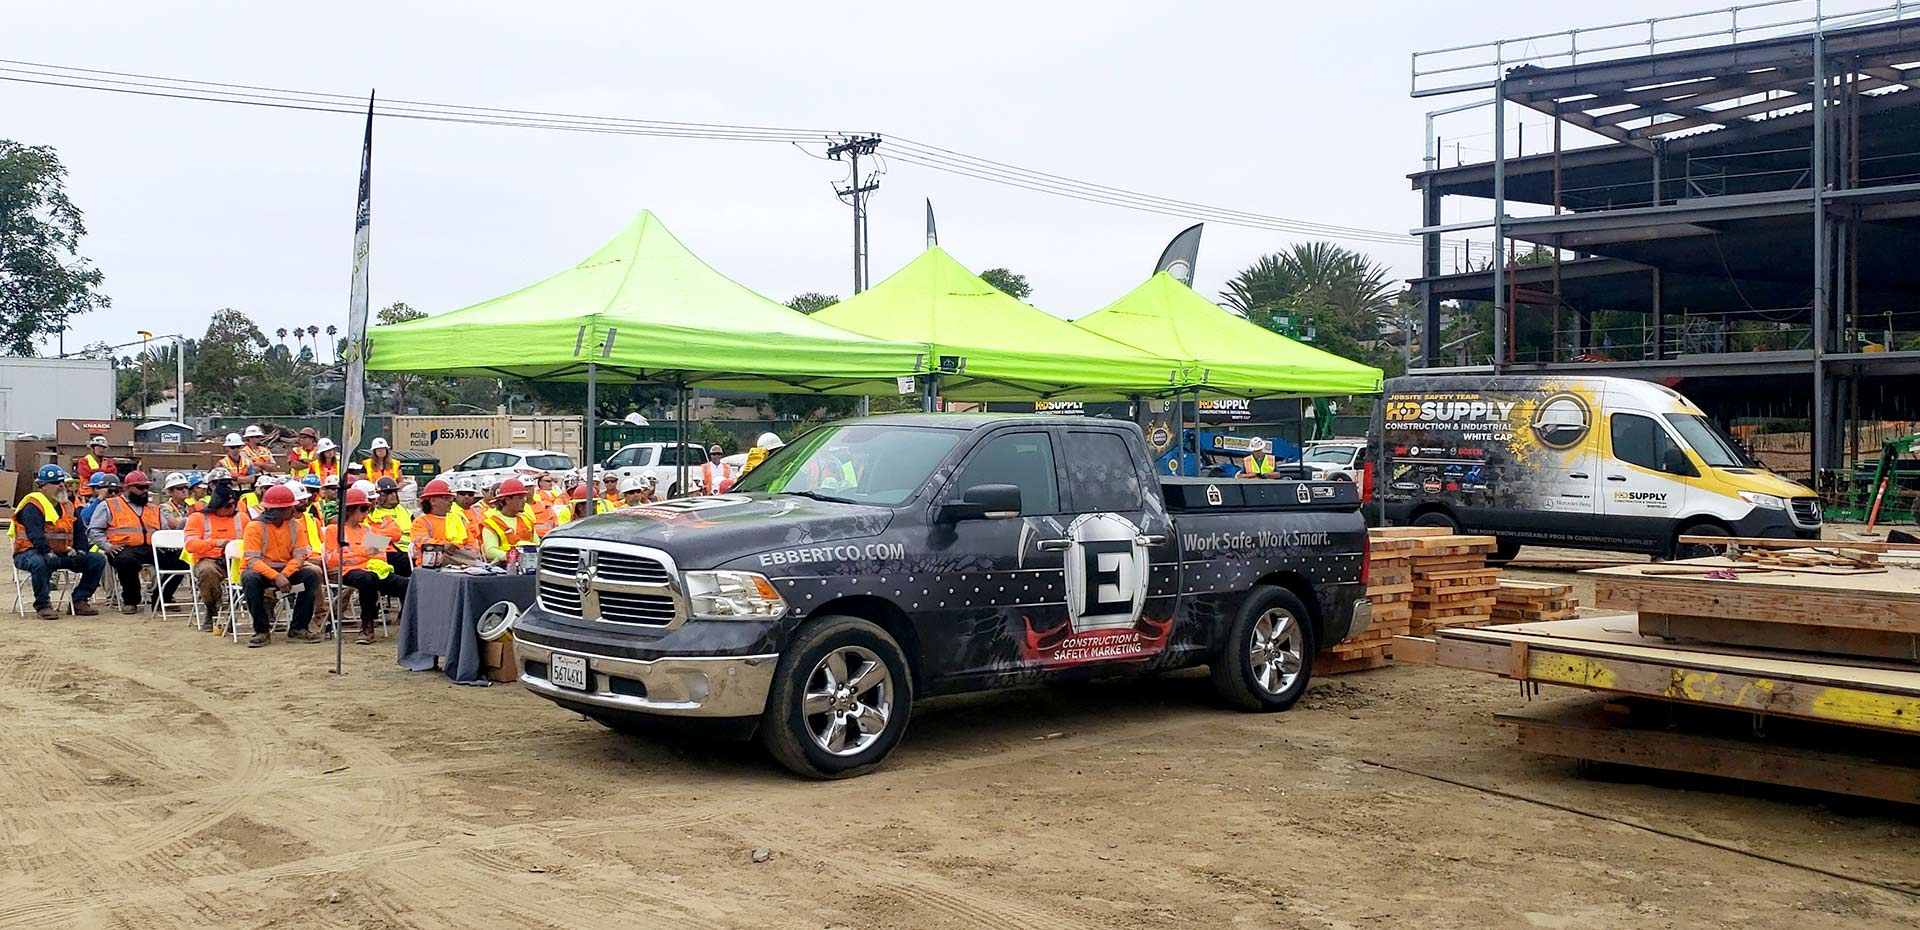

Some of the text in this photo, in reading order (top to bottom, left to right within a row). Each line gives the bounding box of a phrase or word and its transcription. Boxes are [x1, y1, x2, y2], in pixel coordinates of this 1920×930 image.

[1385, 423, 1513, 431] CONSTRUCTION & INDUSTRIAL
[1463, 433, 1513, 441] WHITE CAP
[1183, 529, 1331, 551] Work Safe. Work Smart.
[758, 543, 905, 567] EBBERTCO.COM
[1077, 540, 1135, 617] E
[1062, 632, 1139, 649] CONSTRUCTION &
[1053, 642, 1141, 660] SAFETY MARKETING
